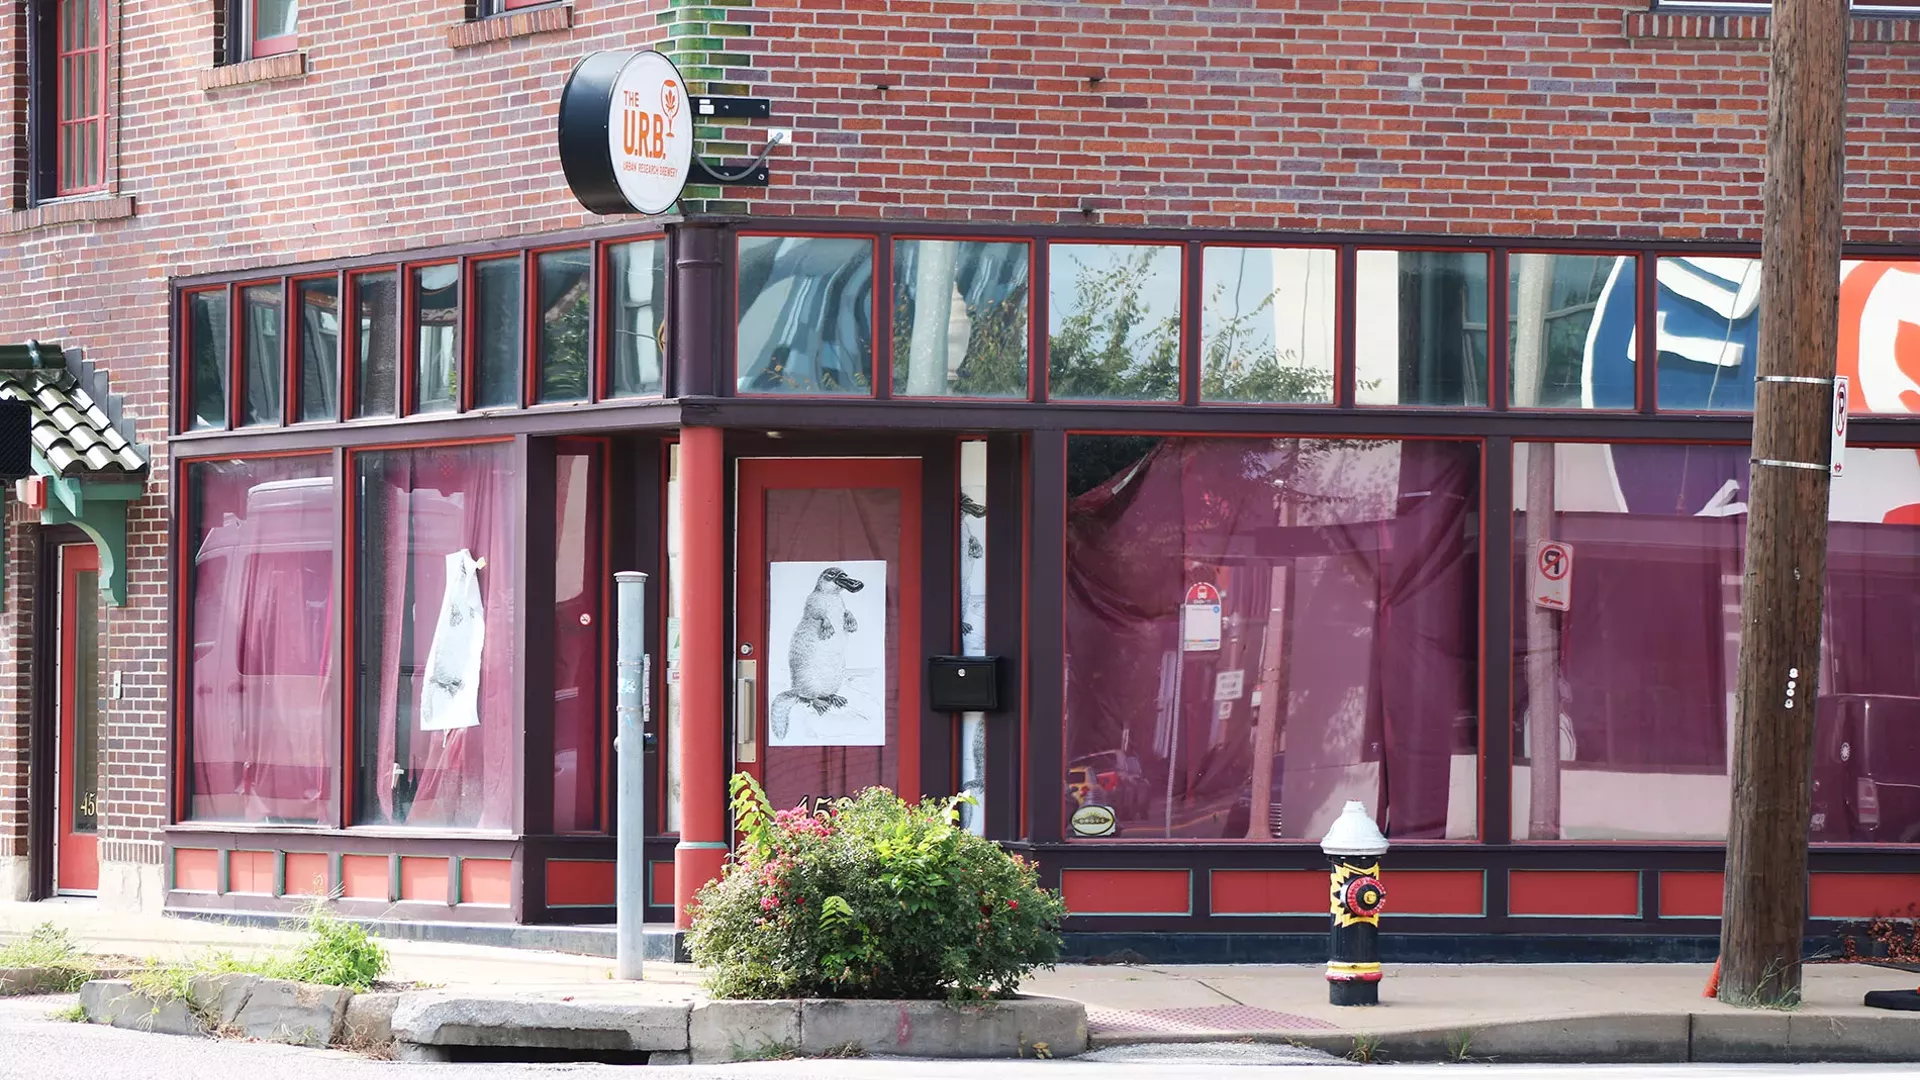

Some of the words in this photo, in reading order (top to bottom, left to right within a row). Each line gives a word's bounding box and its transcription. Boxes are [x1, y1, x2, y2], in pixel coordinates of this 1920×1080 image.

[623, 90, 639, 107] THE
[623, 109, 666, 160] U.R.B.
[623, 161, 637, 171] URBAN
[638, 163, 659, 175] RESEARCH
[659, 165, 678, 178] BREWERY
